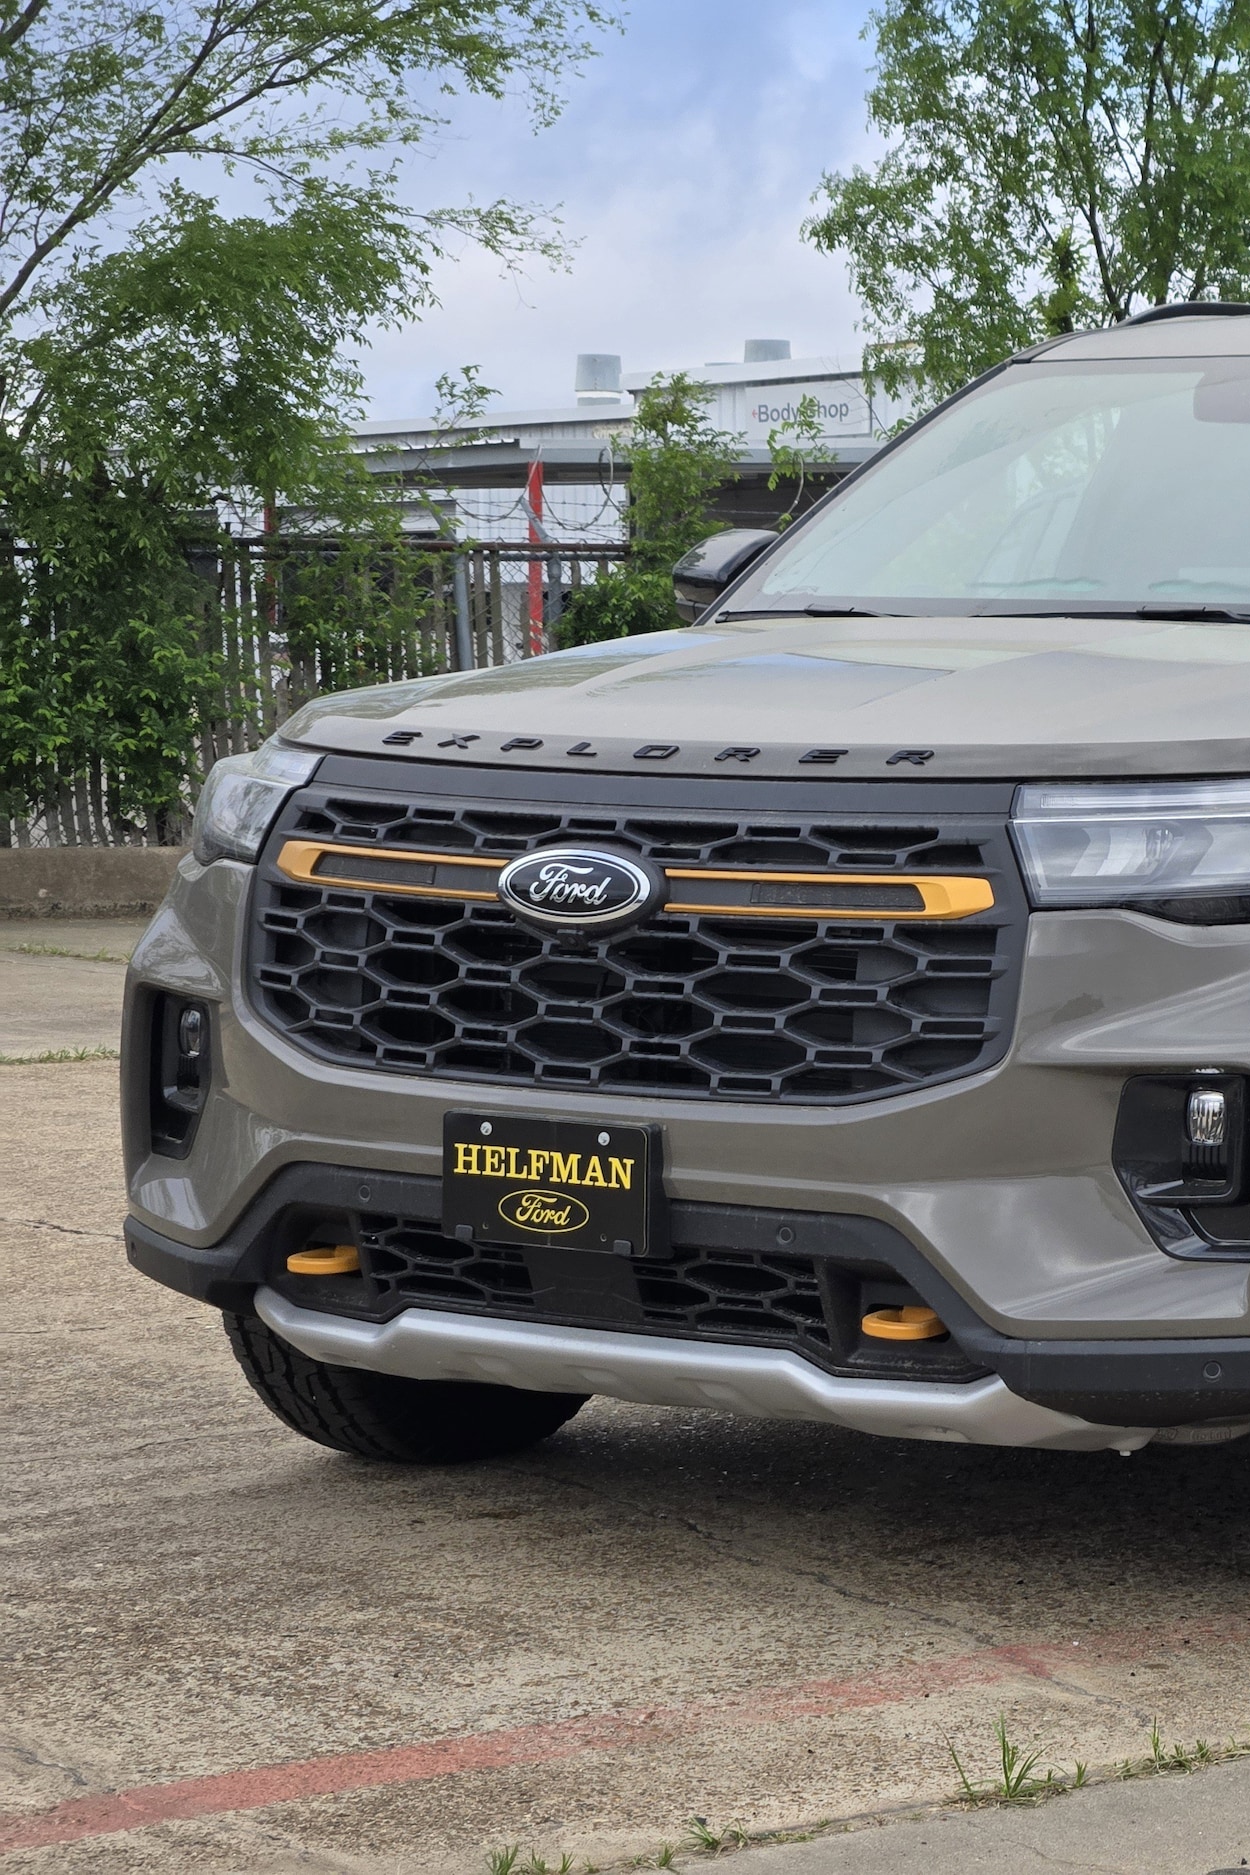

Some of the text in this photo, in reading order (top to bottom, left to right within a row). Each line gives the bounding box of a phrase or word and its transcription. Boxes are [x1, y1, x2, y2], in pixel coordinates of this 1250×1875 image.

[758, 402, 800, 422] Body
[382, 730, 935, 765] EXPLORER
[529, 863, 611, 905] Ford
[453, 1142, 635, 1190] HELFMAN
[515, 1193, 571, 1226] Ford
